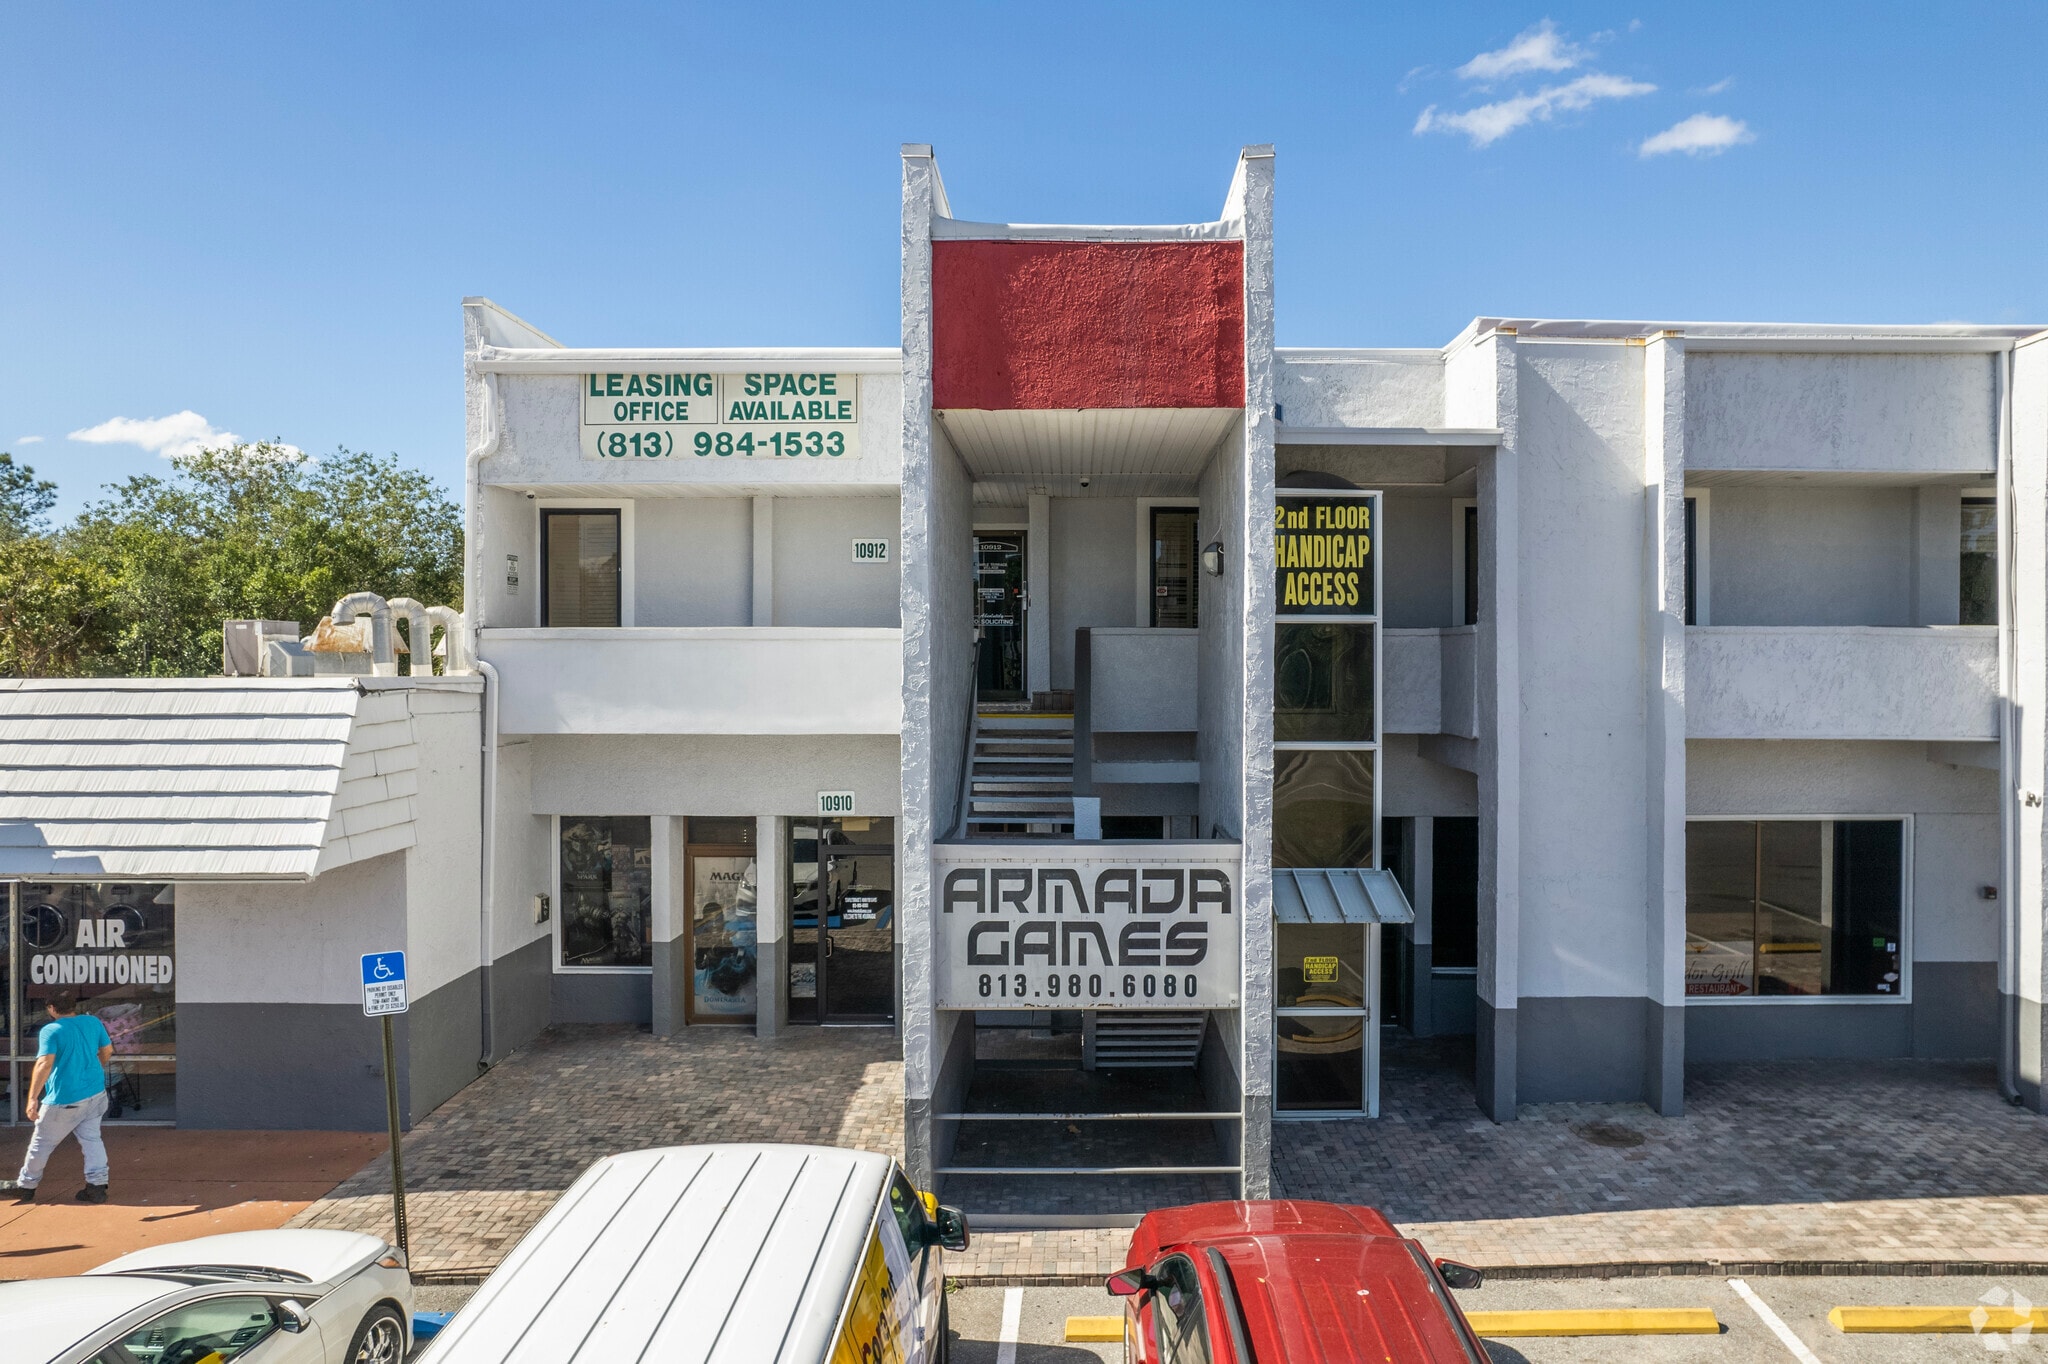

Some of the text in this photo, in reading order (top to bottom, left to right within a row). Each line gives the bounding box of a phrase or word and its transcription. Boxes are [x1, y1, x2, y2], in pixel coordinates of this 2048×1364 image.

[590, 374, 713, 397] LEASING
[744, 374, 837, 396] SPACE
[614, 401, 688, 421] OFFICE
[729, 401, 852, 420] AVAILABLE
[597, 430, 845, 458] (813) 984-1533
[1276, 506, 1369, 529] 2nd FLOOR
[854, 542, 886, 559] 10912
[1276, 534, 1370, 568] HANDICAP
[1284, 572, 1359, 606] ACCESS
[821, 795, 853, 811] 10910
[943, 868, 1231, 914] ARMADA
[76, 918, 125, 948] AIR
[967, 921, 1208, 966] GAMES
[30, 954, 173, 985] CONDITIONED
[1685, 960, 1750, 982] dor Grill
[979, 974, 1197, 998] 813.980.6080
[1689, 984, 1741, 993] RESTAURANT
